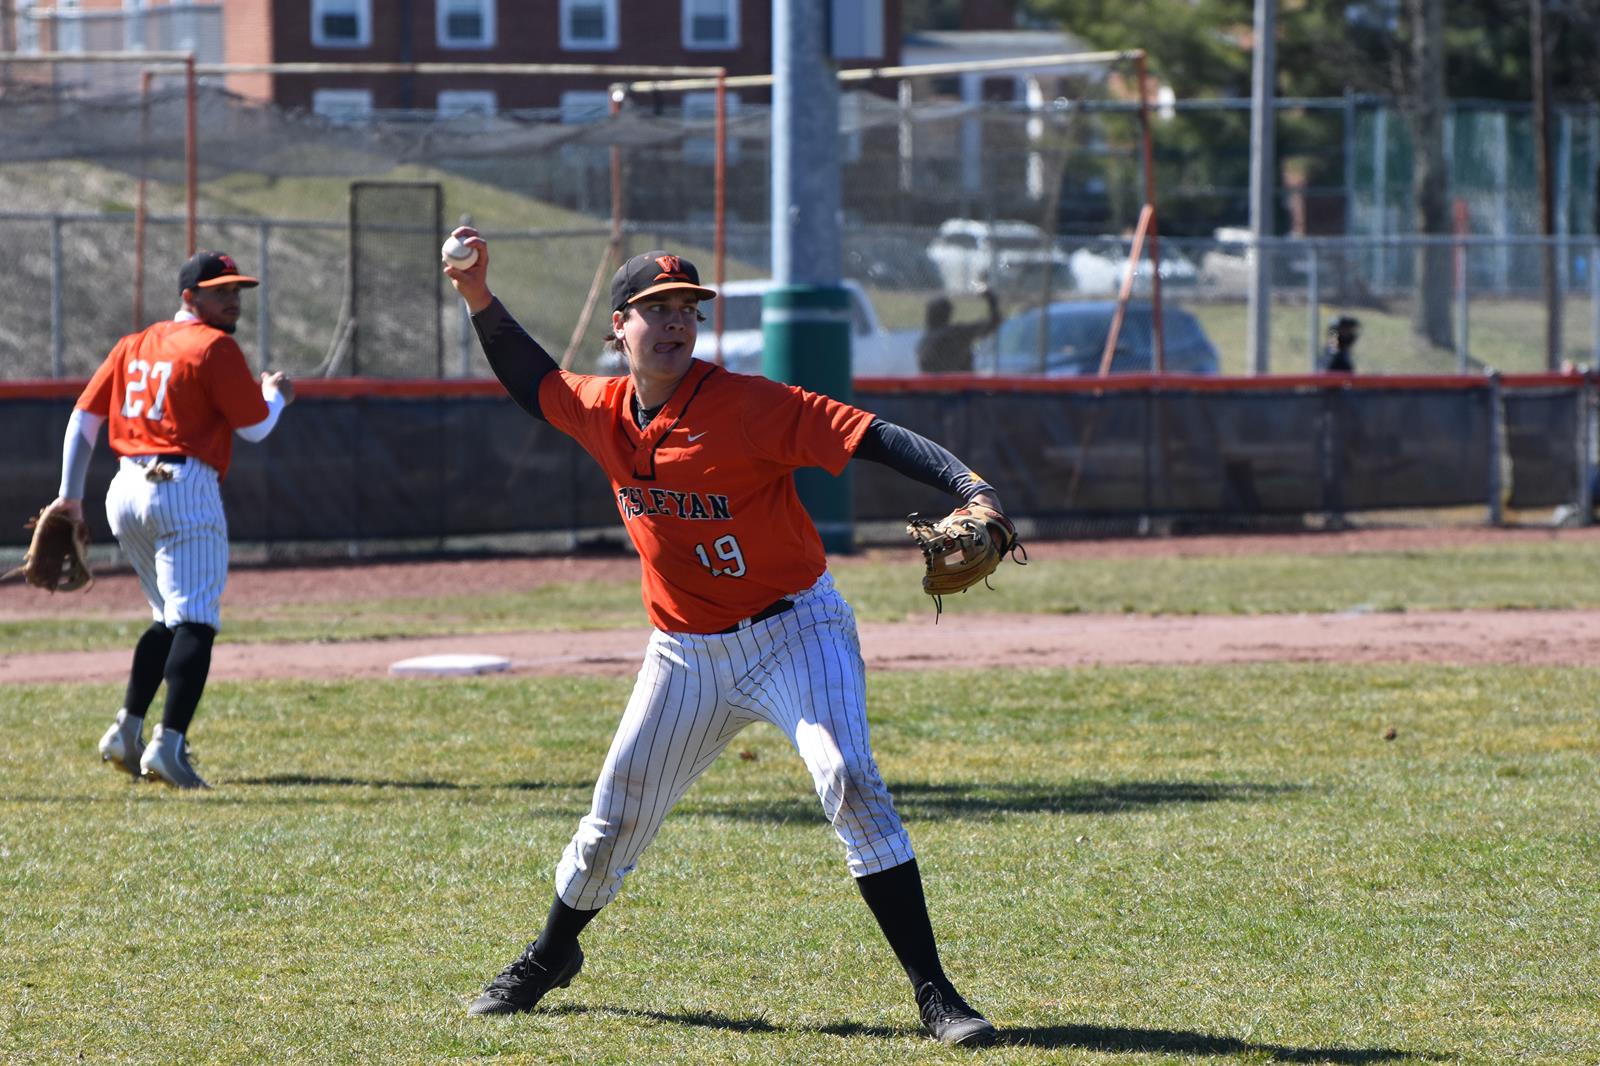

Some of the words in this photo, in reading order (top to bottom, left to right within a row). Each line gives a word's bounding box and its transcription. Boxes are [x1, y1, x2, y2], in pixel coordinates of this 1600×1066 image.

[655, 255, 681, 272] W
[121, 360, 174, 420] 27
[694, 533, 747, 577] 19
